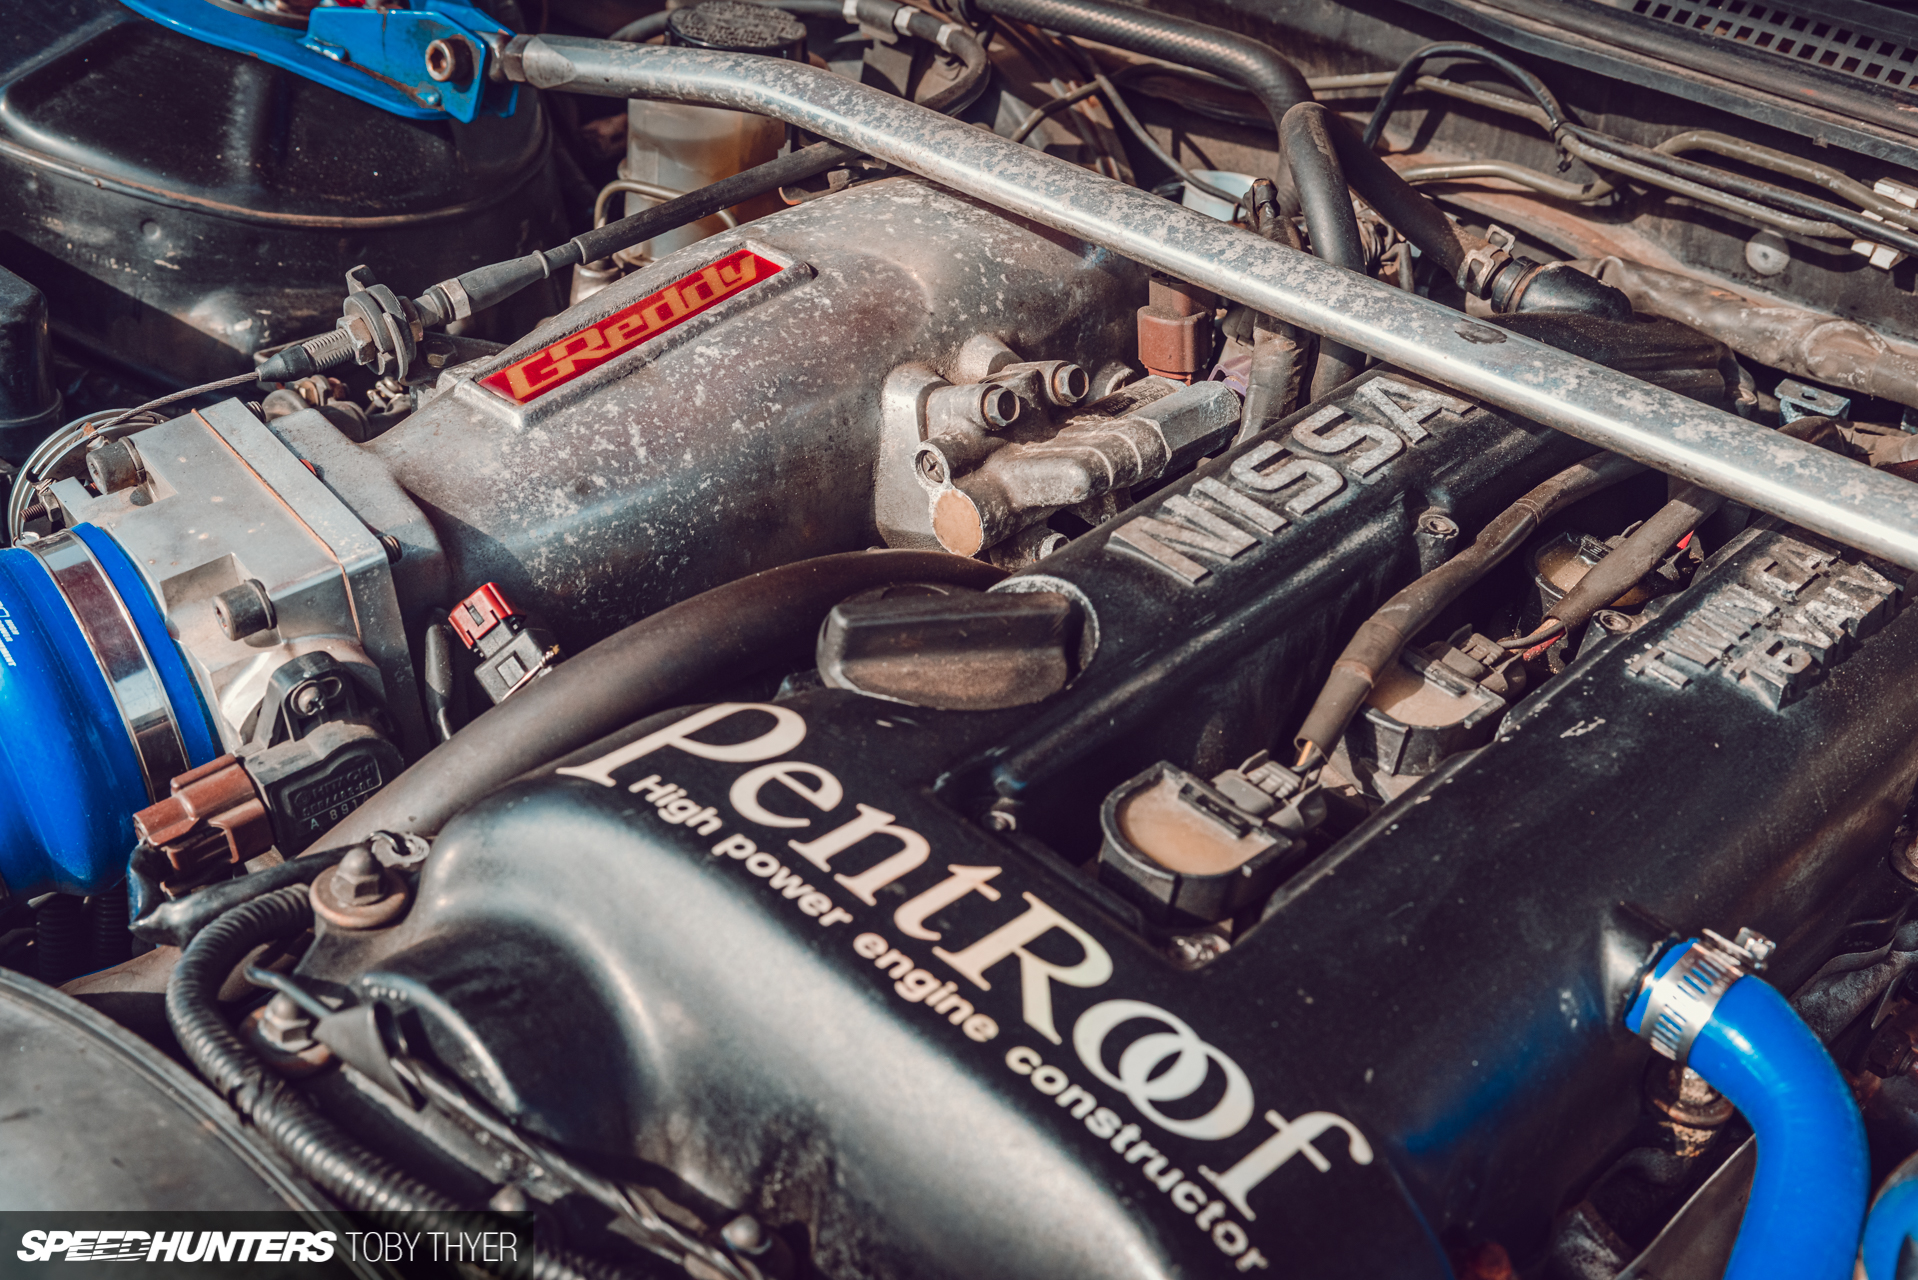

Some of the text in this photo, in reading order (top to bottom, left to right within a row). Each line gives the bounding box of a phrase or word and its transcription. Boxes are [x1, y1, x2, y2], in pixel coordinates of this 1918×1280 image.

[1107, 376, 1476, 584] NISSA
[1748, 538, 1842, 602] CA
[1775, 561, 1900, 655] VALV
[555, 701, 1374, 1223] PentRoof
[628, 774, 1269, 1273] High power engine constructor
